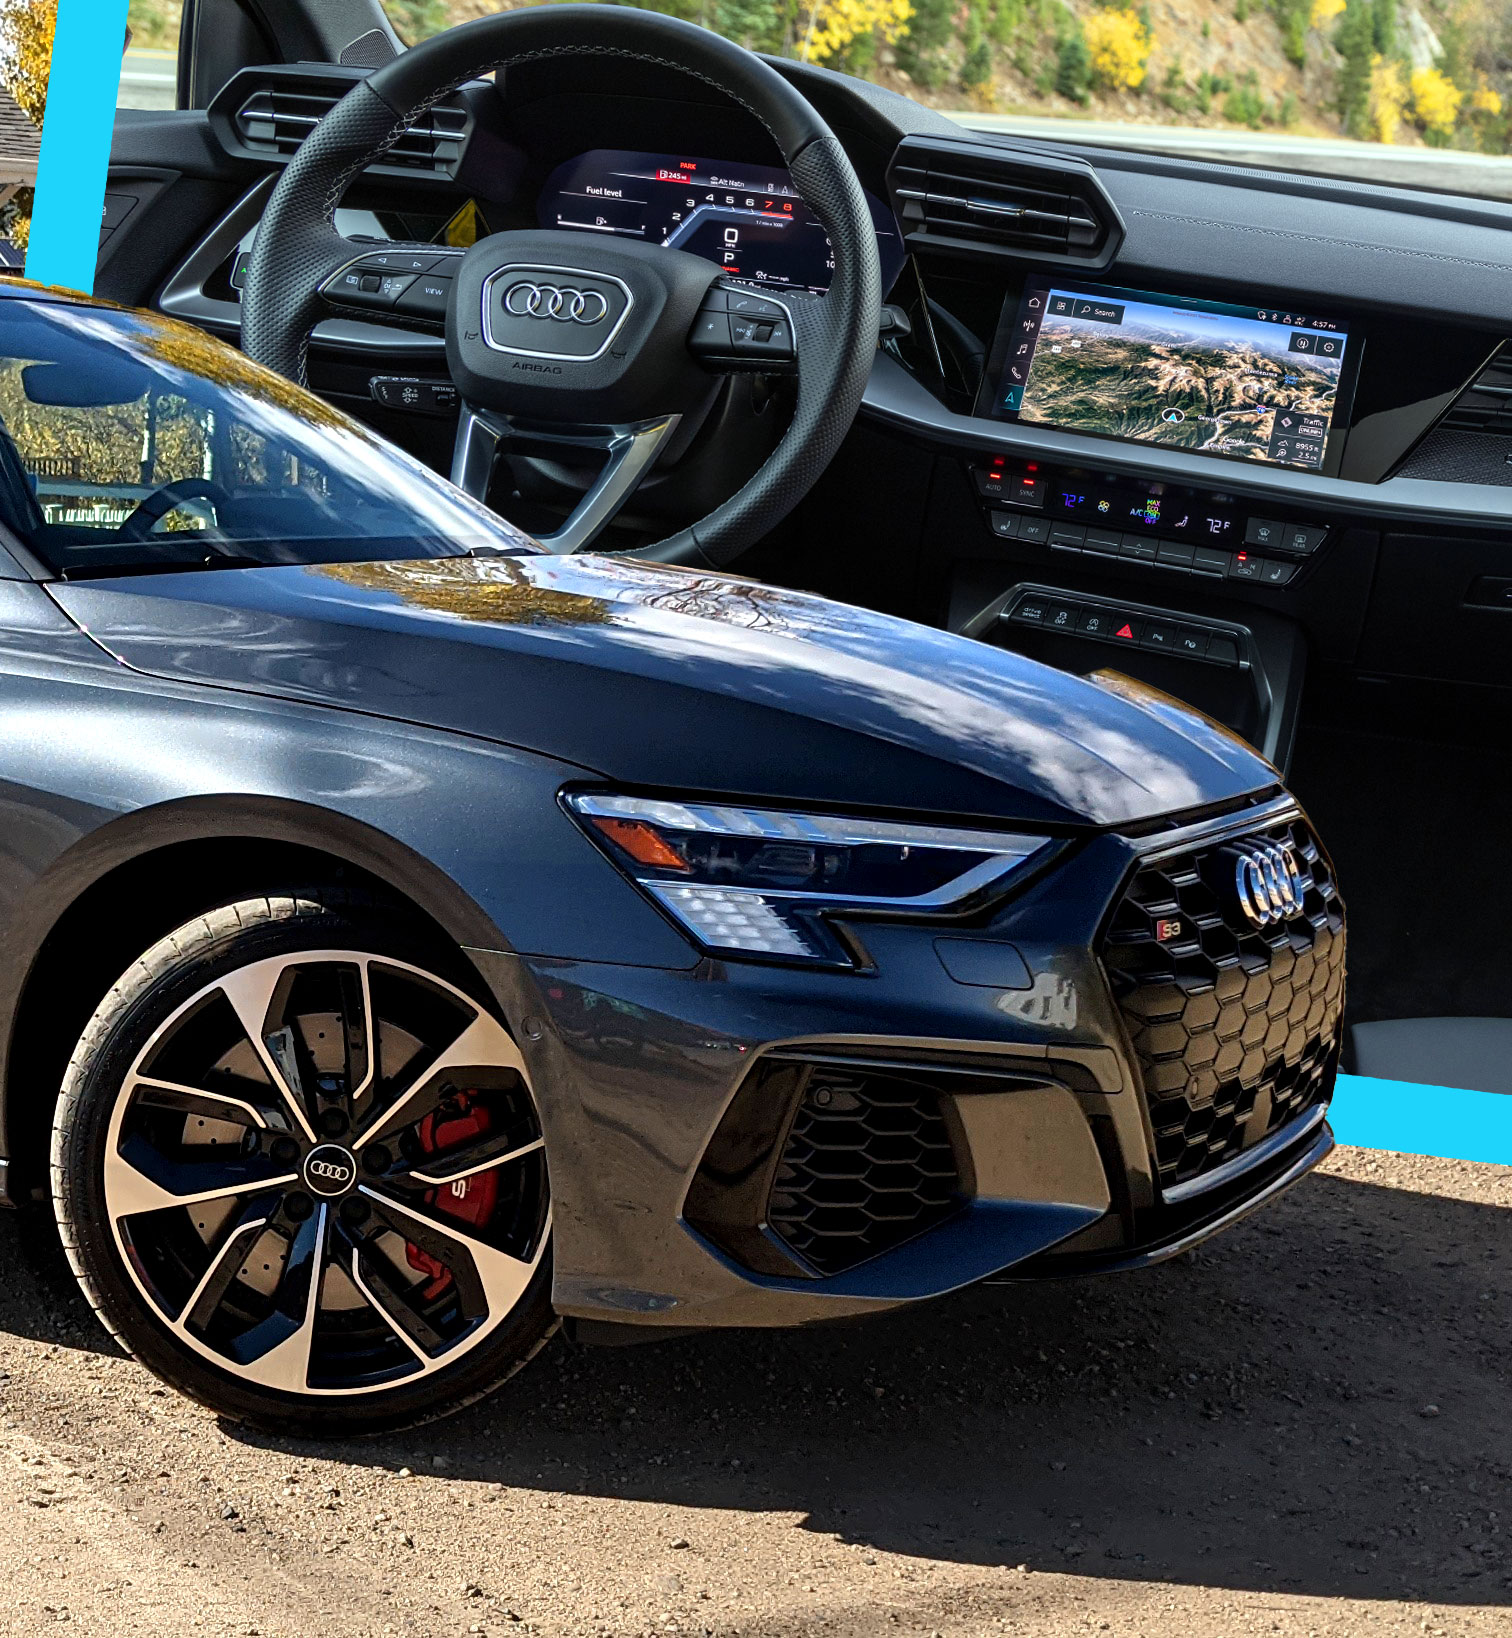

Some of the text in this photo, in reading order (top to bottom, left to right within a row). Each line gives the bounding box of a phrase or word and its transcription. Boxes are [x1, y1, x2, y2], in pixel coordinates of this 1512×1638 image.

[680, 162, 697, 170] PARK
[668, 171, 681, 180] 245
[586, 186, 622, 198] Fuel level
[686, 199, 696, 207] 3
[725, 196, 735, 204] 5
[745, 199, 755, 207] 6
[783, 203, 792, 211] 8
[672, 212, 681, 220] 2
[724, 228, 739, 243] 0
[724, 252, 735, 263] P
[826, 260, 836, 269] 10
[425, 287, 444, 296] VIEW
[1094, 308, 1116, 318] Search
[1312, 320, 1328, 329] 4:57
[512, 362, 562, 375] AIRBAG
[1303, 417, 1324, 427] Traffic
[1222, 435, 1246, 446] Google
[1295, 442, 1314, 452] 8955
[1298, 451, 1310, 460] 2.5
[985, 483, 1002, 491] AUTO
[1019, 489, 1035, 498] SYNC
[1062, 493, 1076, 507] 72
[1147, 499, 1160, 507] MAX
[1130, 508, 1143, 517] A/C
[1207, 518, 1231, 533] 72 F
[1024, 607, 1042, 615] drive
[1162, 922, 1181, 938] S3
[451, 1179, 466, 1199] S
